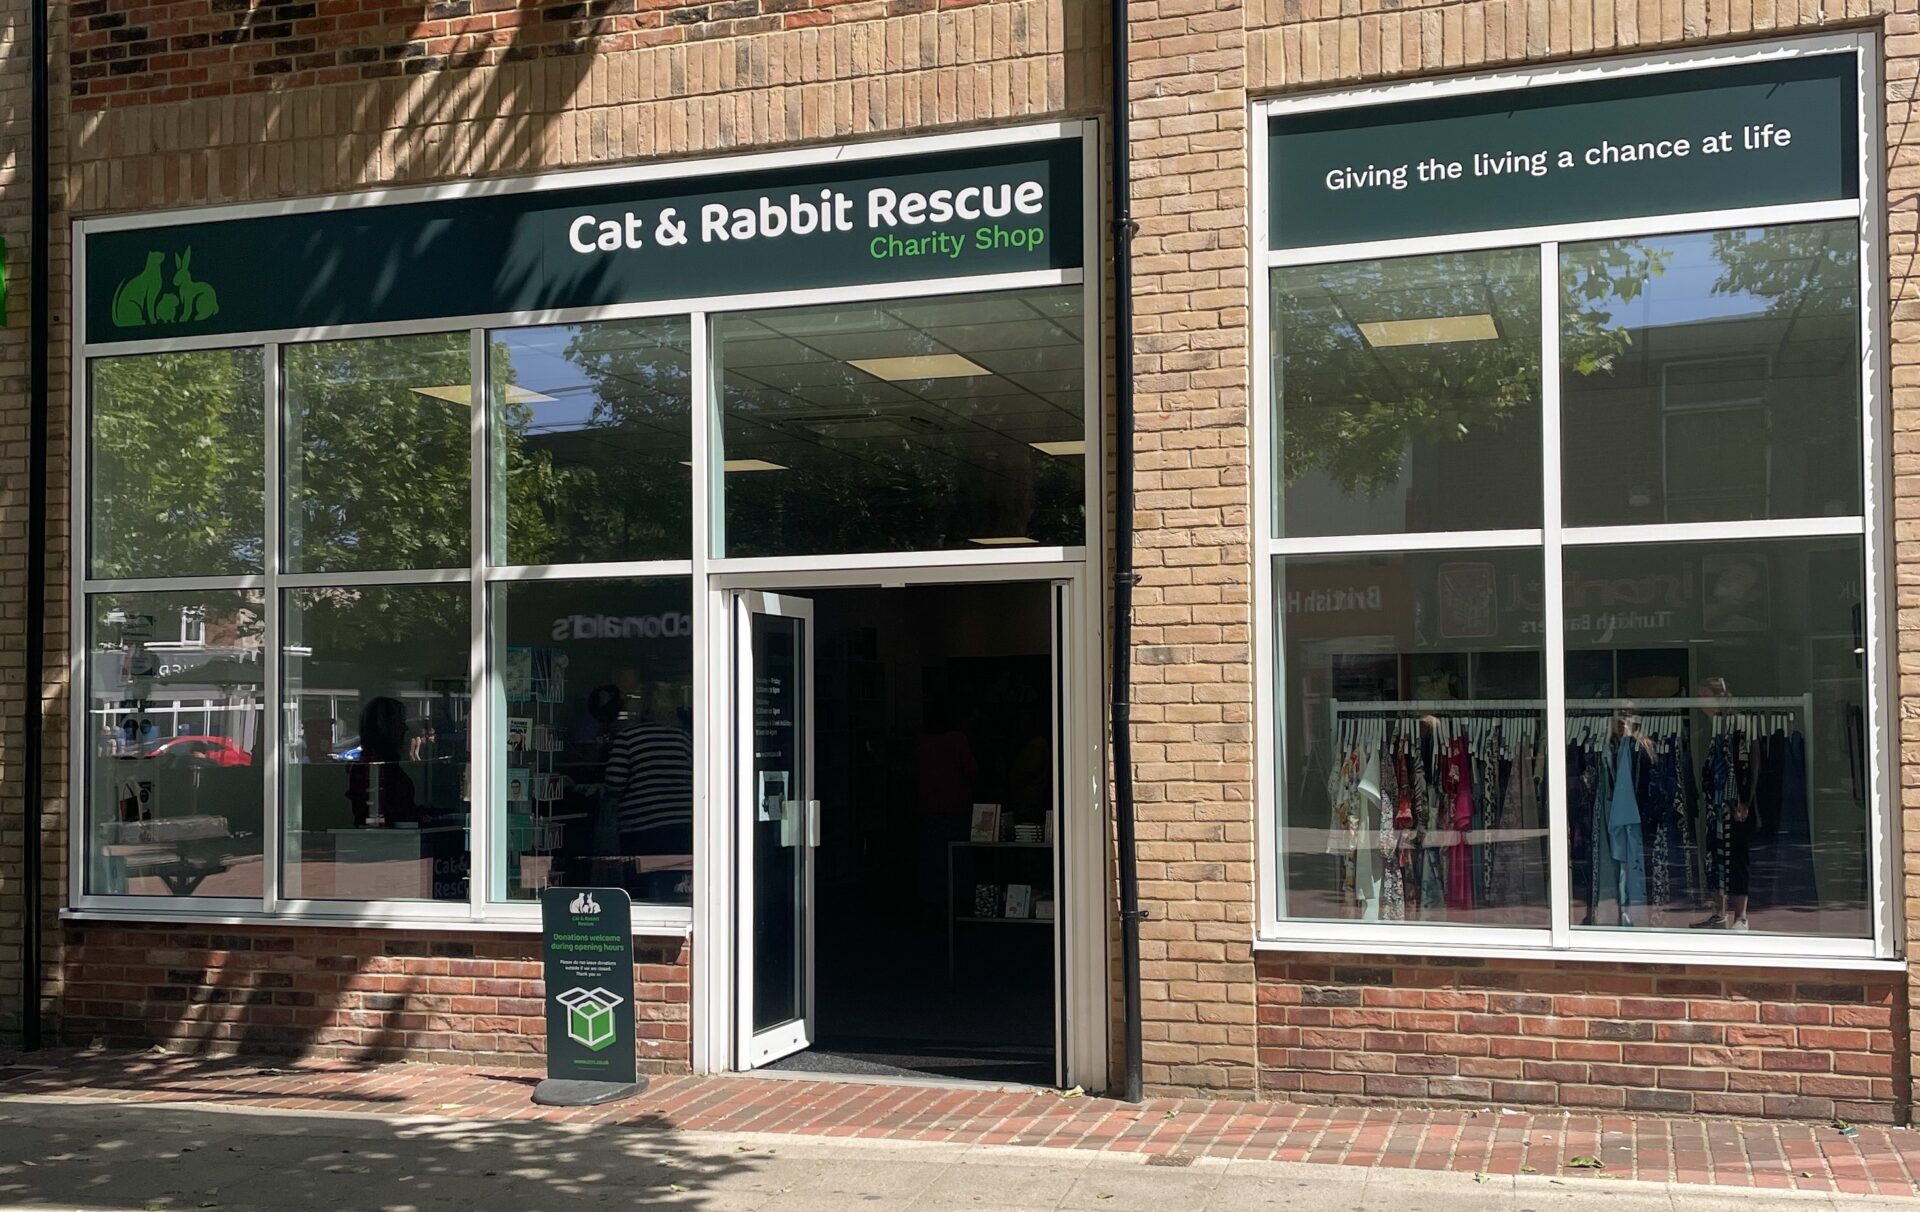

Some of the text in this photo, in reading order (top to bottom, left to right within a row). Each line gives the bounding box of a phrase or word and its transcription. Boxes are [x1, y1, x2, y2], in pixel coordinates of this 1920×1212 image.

[1325, 123, 1792, 190] Giving the living a chance at life
[568, 181, 1044, 254] Cat & Rabbit Rescue
[869, 223, 1045, 260] Charity Shop
[434, 857, 457, 875] Cat
[434, 881, 467, 898] Resc
[553, 933, 621, 942] Donations welcome
[551, 943, 625, 952] during opening hours
